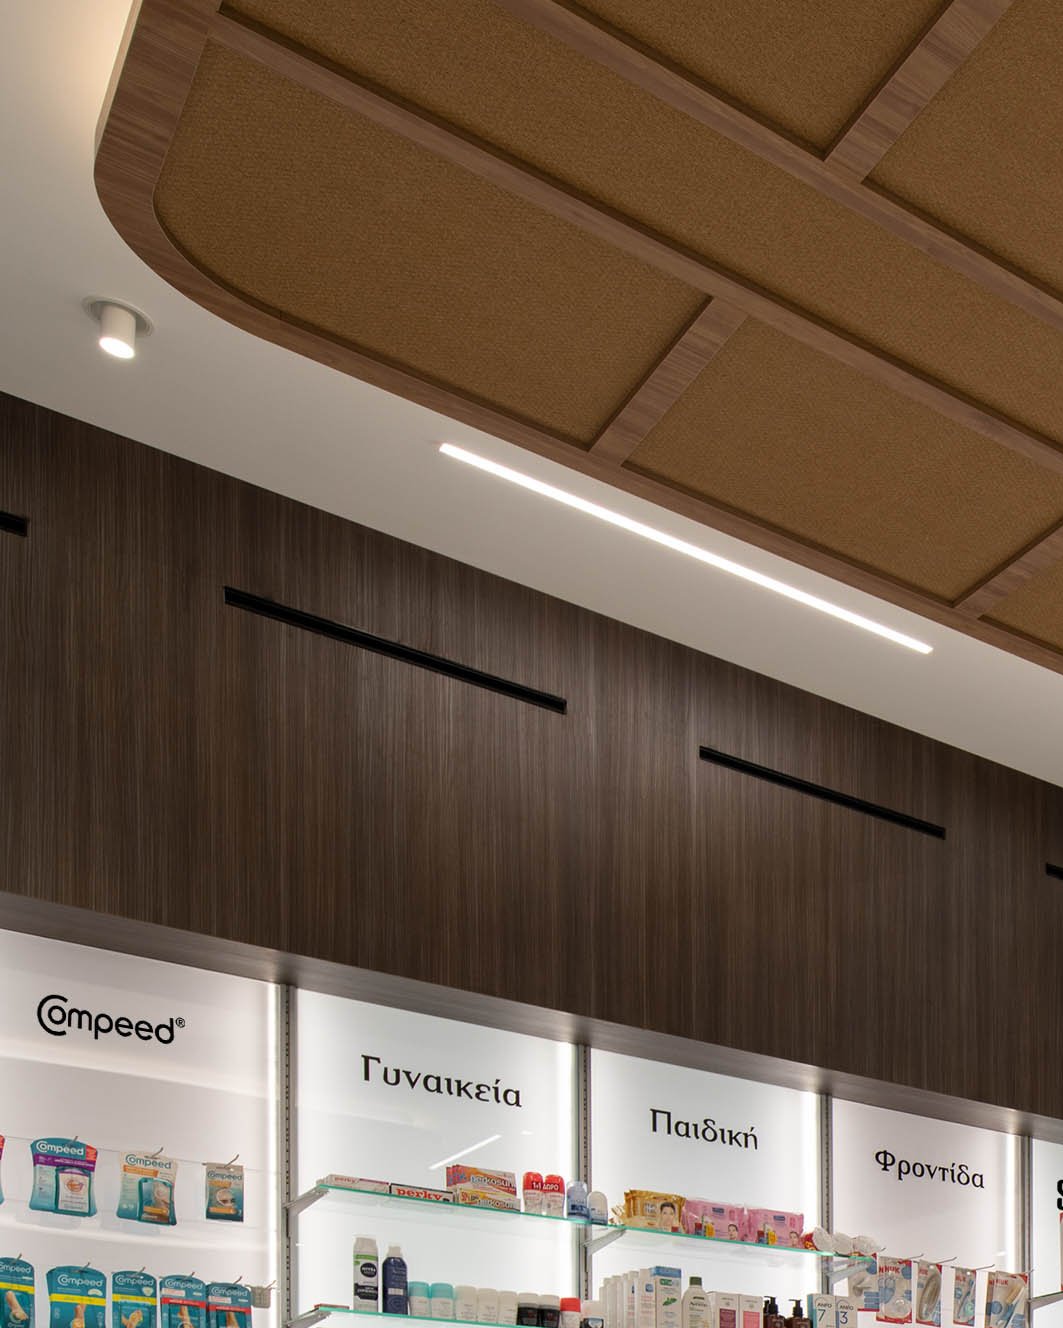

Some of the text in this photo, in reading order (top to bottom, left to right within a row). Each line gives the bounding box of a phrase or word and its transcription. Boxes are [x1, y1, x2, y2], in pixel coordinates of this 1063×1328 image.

[361, 1054, 522, 1107] Γυναικεία
[650, 1108, 758, 1150] Παιδική
[36, 1140, 84, 1156] Compeed
[125, 1154, 172, 1169] Compeed
[208, 1170, 243, 1181] Compeed
[875, 1150, 985, 1188] Φροντίδα
[57, 1274, 103, 1288] Compeed
[115, 1274, 153, 1287] Compeed
[165, 1278, 203, 1290] Compeed
[211, 1286, 248, 1298] Compeed
[817, 1309, 826, 1322] 7
[840, 1311, 848, 1325] 3
